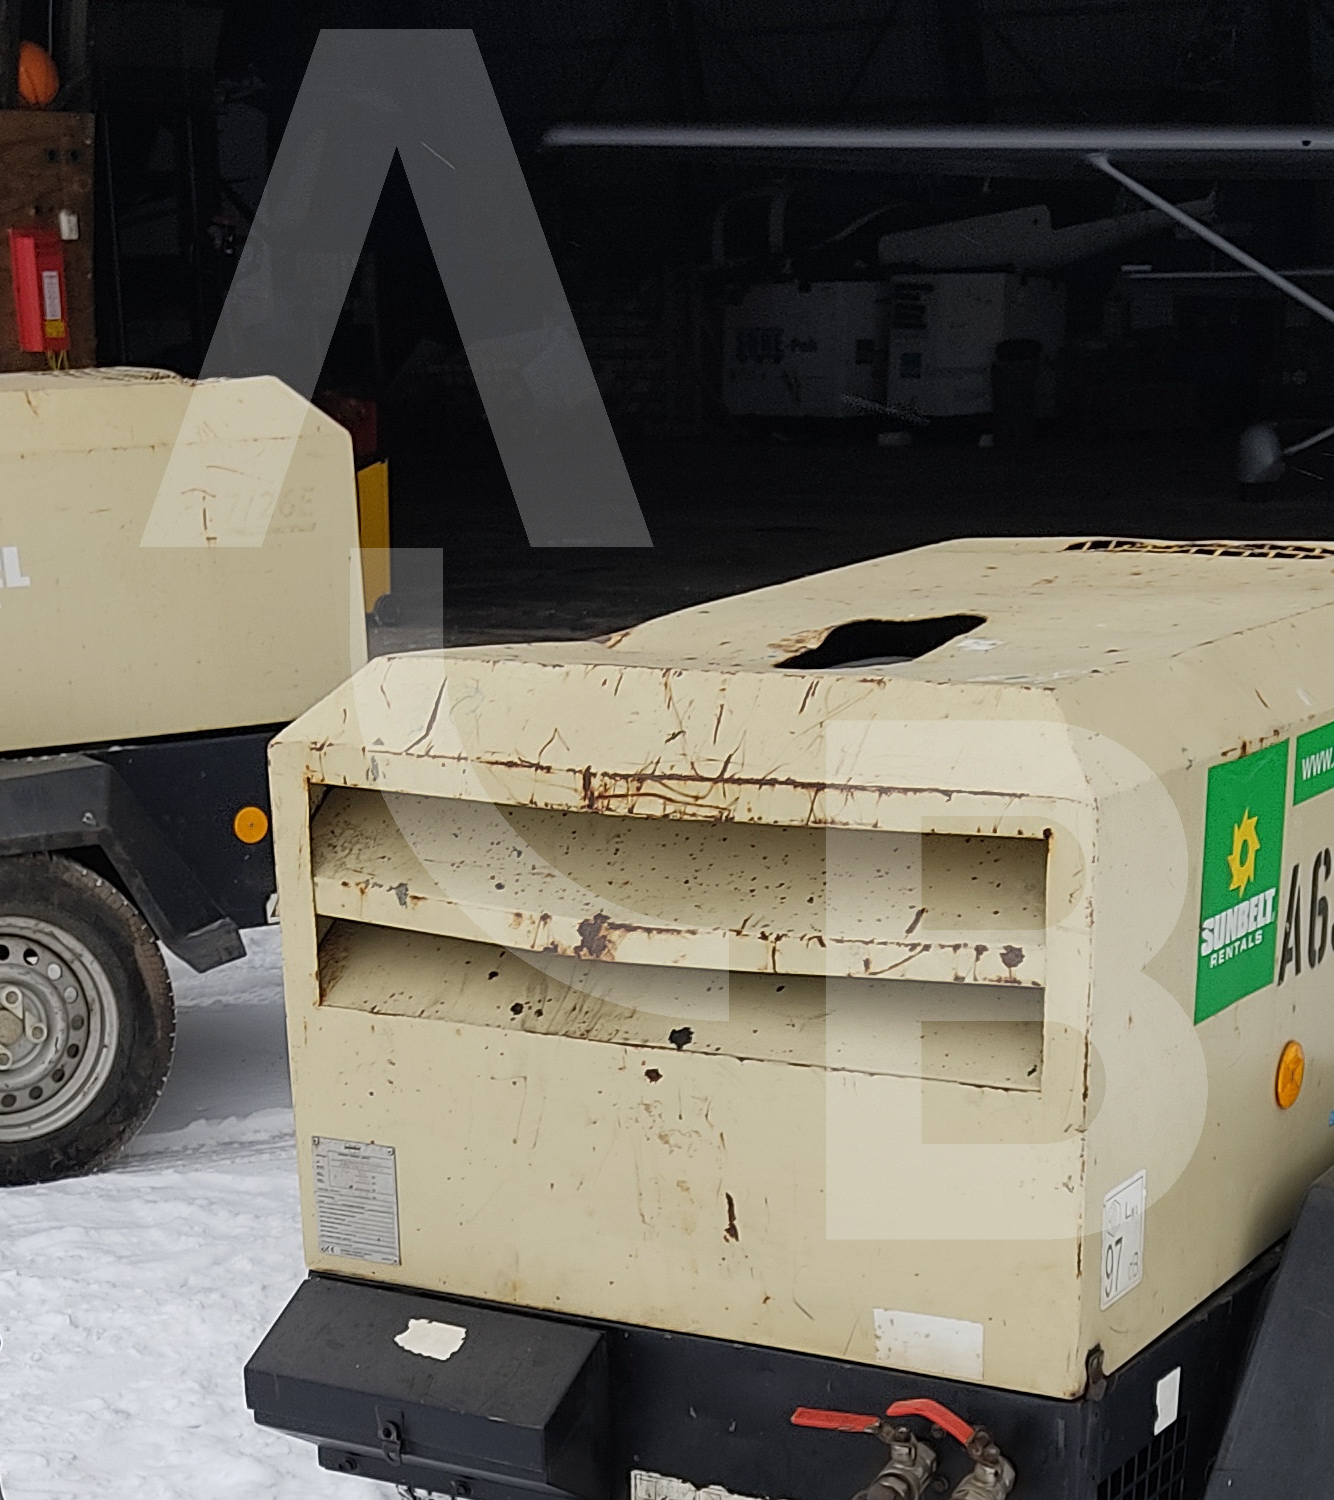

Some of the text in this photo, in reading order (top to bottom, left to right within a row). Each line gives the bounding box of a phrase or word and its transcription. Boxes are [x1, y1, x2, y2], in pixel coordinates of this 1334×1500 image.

[1201, 887, 1277, 957] SUNBELT
[1210, 929, 1263, 969] RENTALS
[1105, 1236, 1123, 1298] 97
